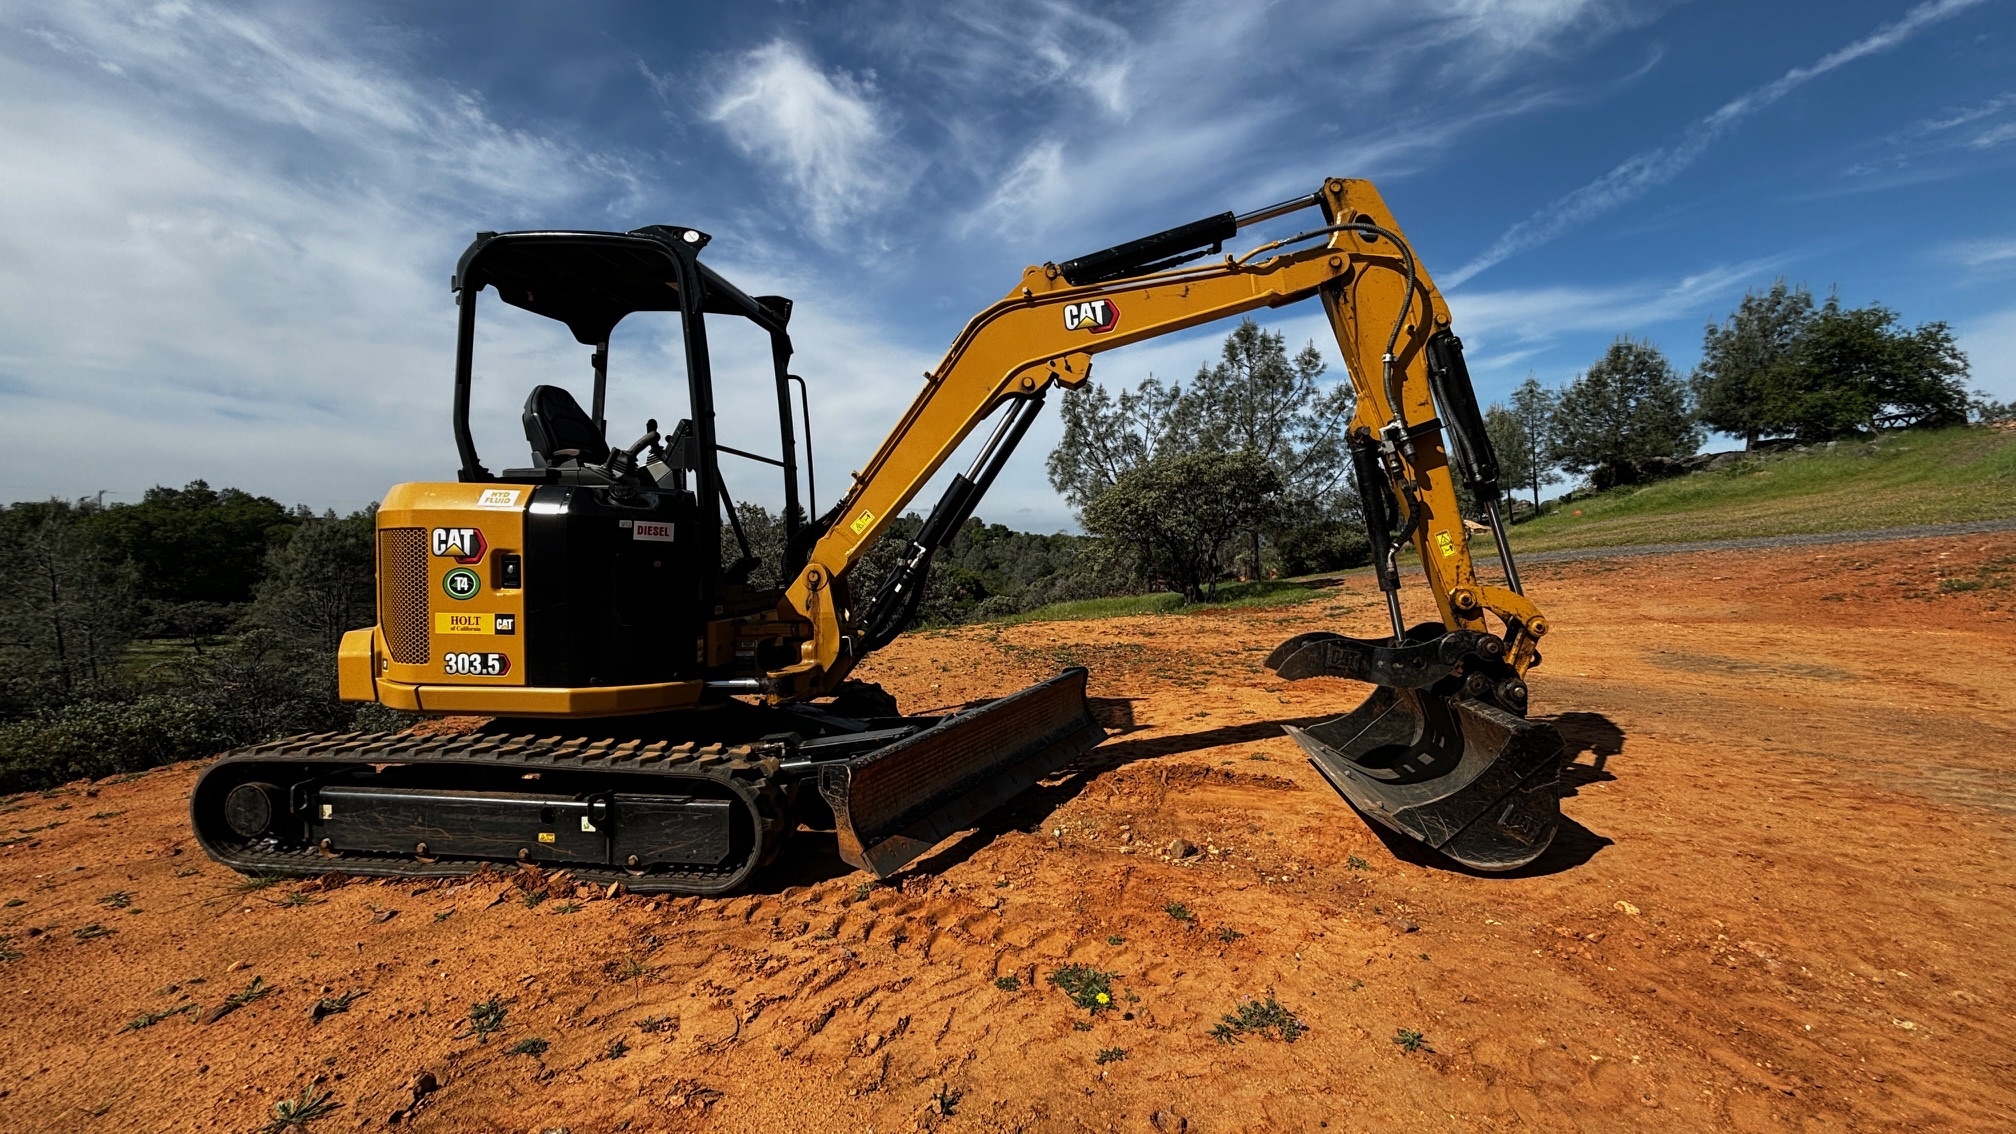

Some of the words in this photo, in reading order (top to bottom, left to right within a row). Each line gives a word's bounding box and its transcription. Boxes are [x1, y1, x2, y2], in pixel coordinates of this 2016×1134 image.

[1064, 301, 1105, 330] CAT
[637, 525, 670, 537] DIESEL
[432, 528, 474, 556] CAT
[454, 576, 469, 591] T4
[451, 616, 481, 625] HOLT
[496, 618, 514, 630] CAT
[445, 653, 500, 674] 303.5
